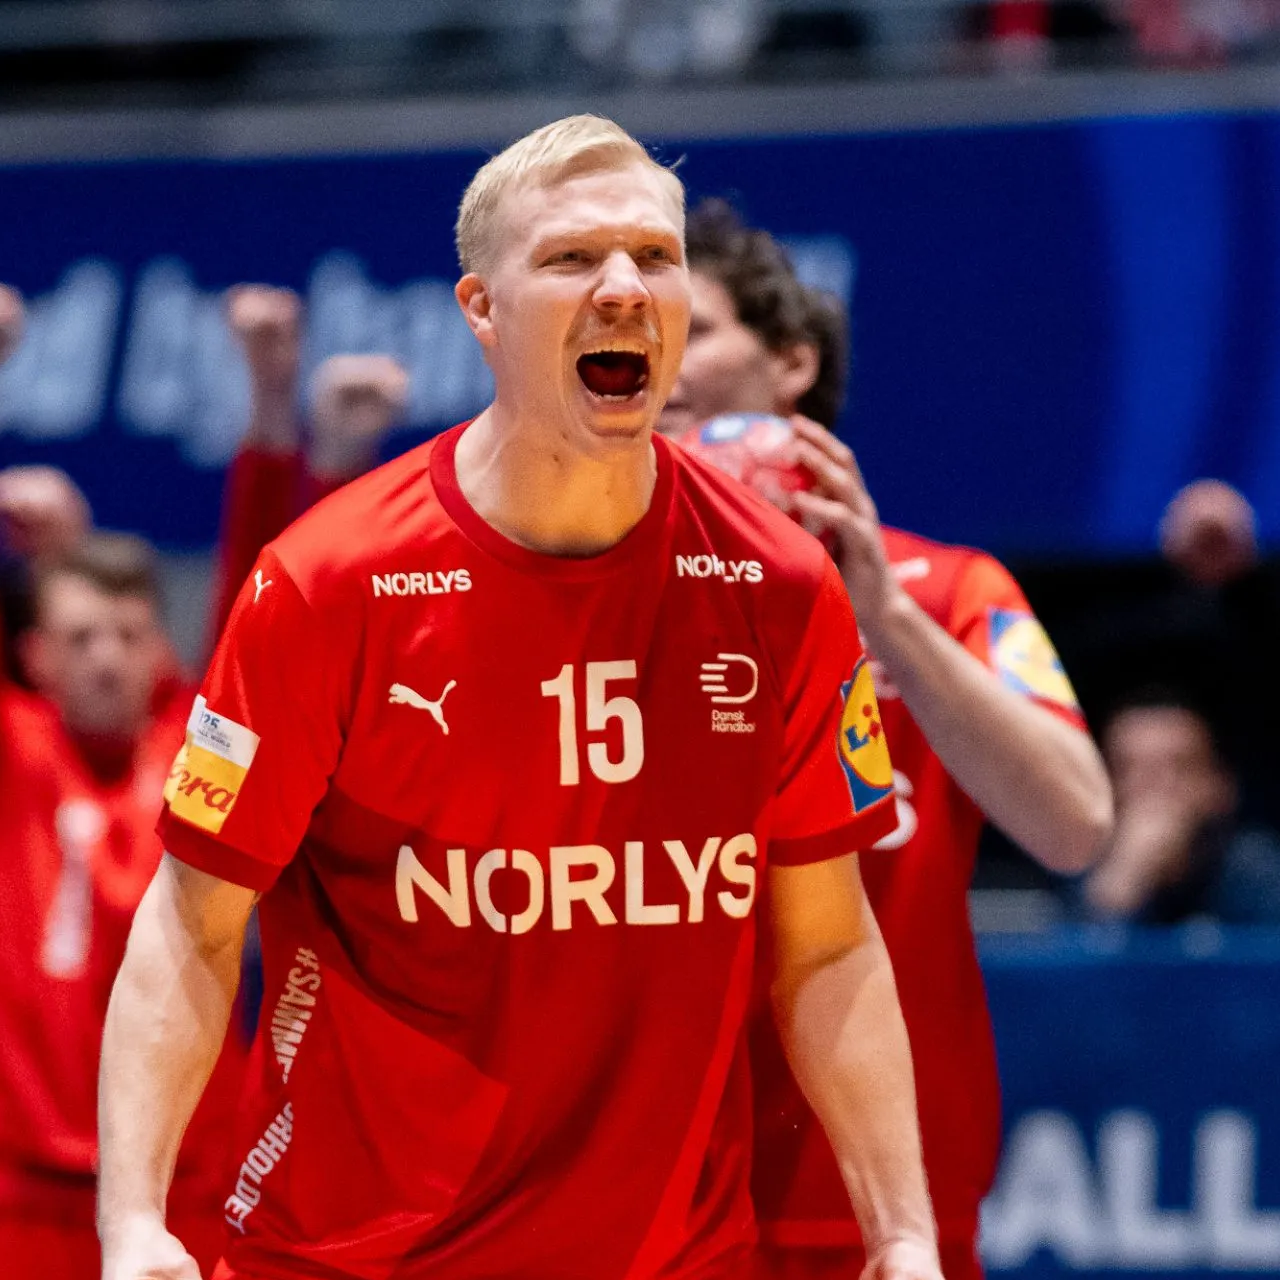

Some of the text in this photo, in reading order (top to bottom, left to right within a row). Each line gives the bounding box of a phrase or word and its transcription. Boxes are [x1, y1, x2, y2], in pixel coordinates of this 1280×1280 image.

[372, 569, 472, 597] NORLYS
[542, 660, 644, 786] 15
[395, 832, 758, 935] NORLYS
